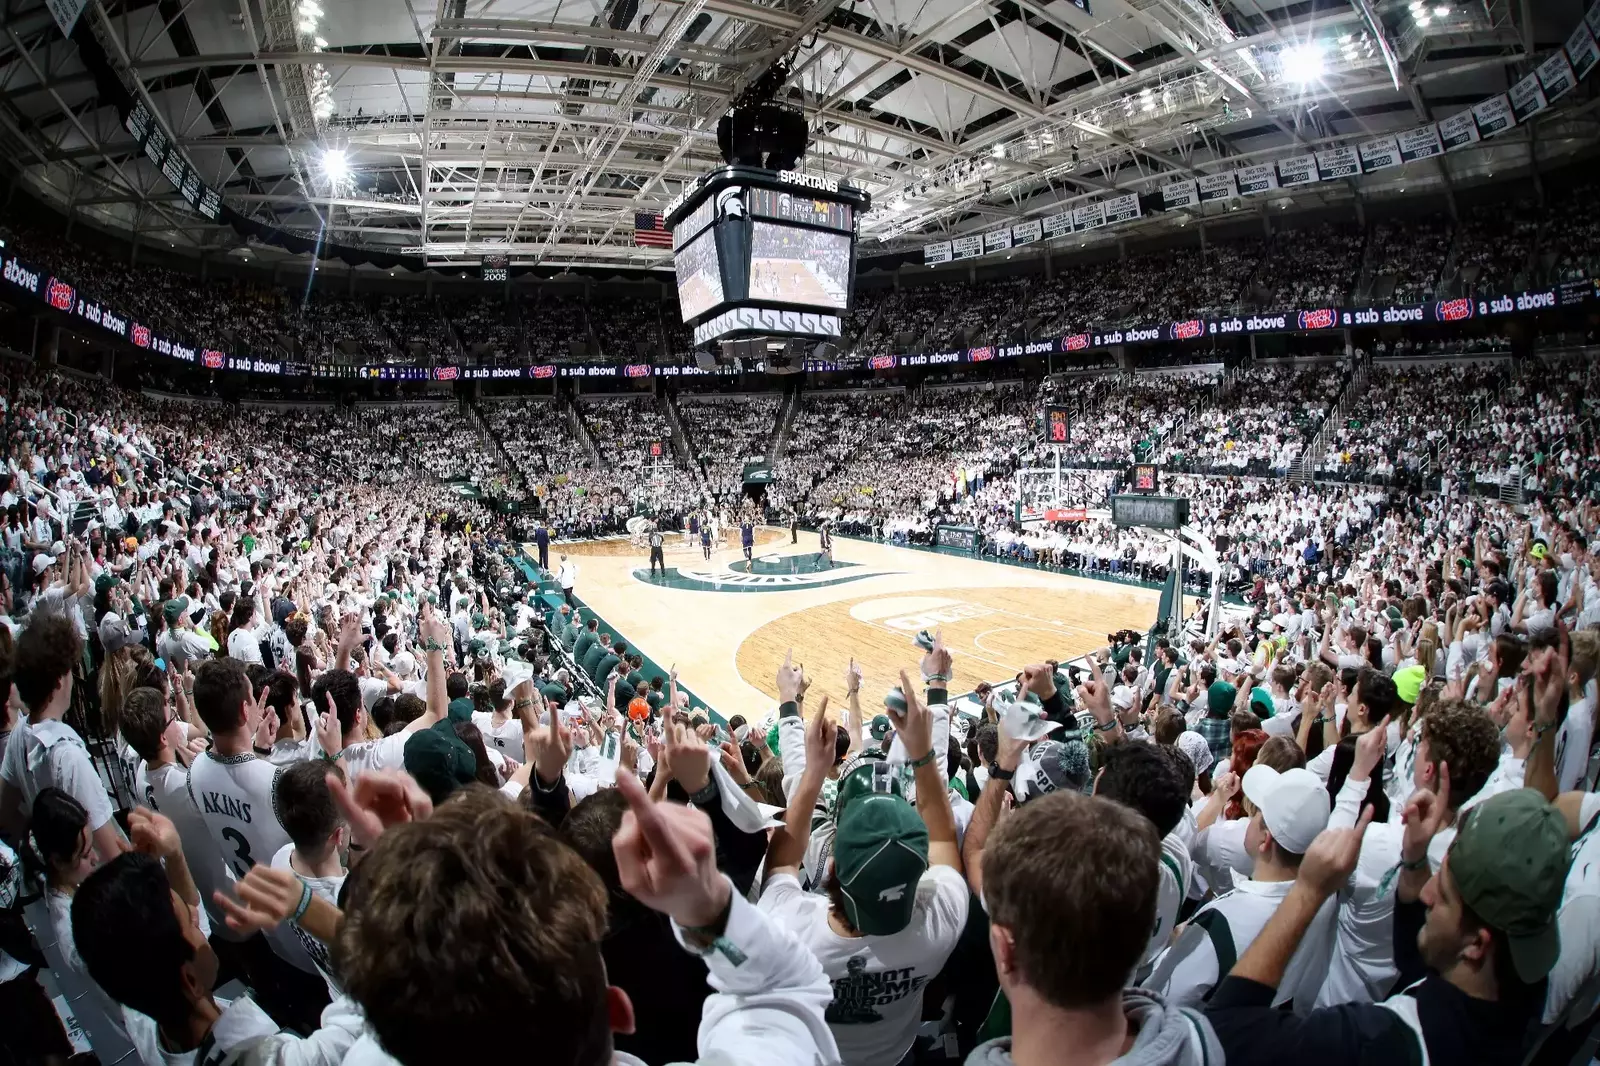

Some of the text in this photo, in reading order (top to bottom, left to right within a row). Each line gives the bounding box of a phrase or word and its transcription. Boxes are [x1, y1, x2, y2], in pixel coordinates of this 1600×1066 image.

[1281, 163, 1315, 174] CHAMPIONS
[780, 169, 838, 193] SPARTANS
[1201, 180, 1234, 191] CHAMPIONS
[1241, 172, 1275, 183] CHAMPIONS
[4, 257, 38, 292] above
[483, 273, 507, 281] 2005
[1479, 301, 1488, 315] a
[1491, 295, 1513, 313] sub
[1517, 291, 1555, 310] above
[78, 300, 84, 316] a
[86, 303, 101, 323] sub
[103, 310, 126, 335] above
[1343, 307, 1423, 324] a sub above
[1209, 316, 1285, 334] a sub above
[1095, 328, 1159, 345] a sub above
[152, 337, 157, 350] a
[158, 338, 171, 355] sub
[172, 342, 195, 361] above
[999, 348, 1005, 357] a
[1007, 344, 1023, 357] sub
[1025, 342, 1053, 354] above
[229, 358, 234, 369] a
[236, 357, 251, 371] sub
[253, 360, 281, 374] above
[901, 357, 907, 366] a
[910, 355, 927, 365] sub
[930, 352, 959, 363] above
[464, 369, 470, 378] a
[472, 368, 489, 378] sub
[492, 368, 520, 378] above
[561, 368, 567, 376] a
[569, 366, 585, 376] sub
[588, 366, 615, 376] above
[655, 367, 660, 376] a
[662, 365, 678, 376] sub
[201, 791, 252, 824] AKINS
[221, 826, 257, 879] 3
